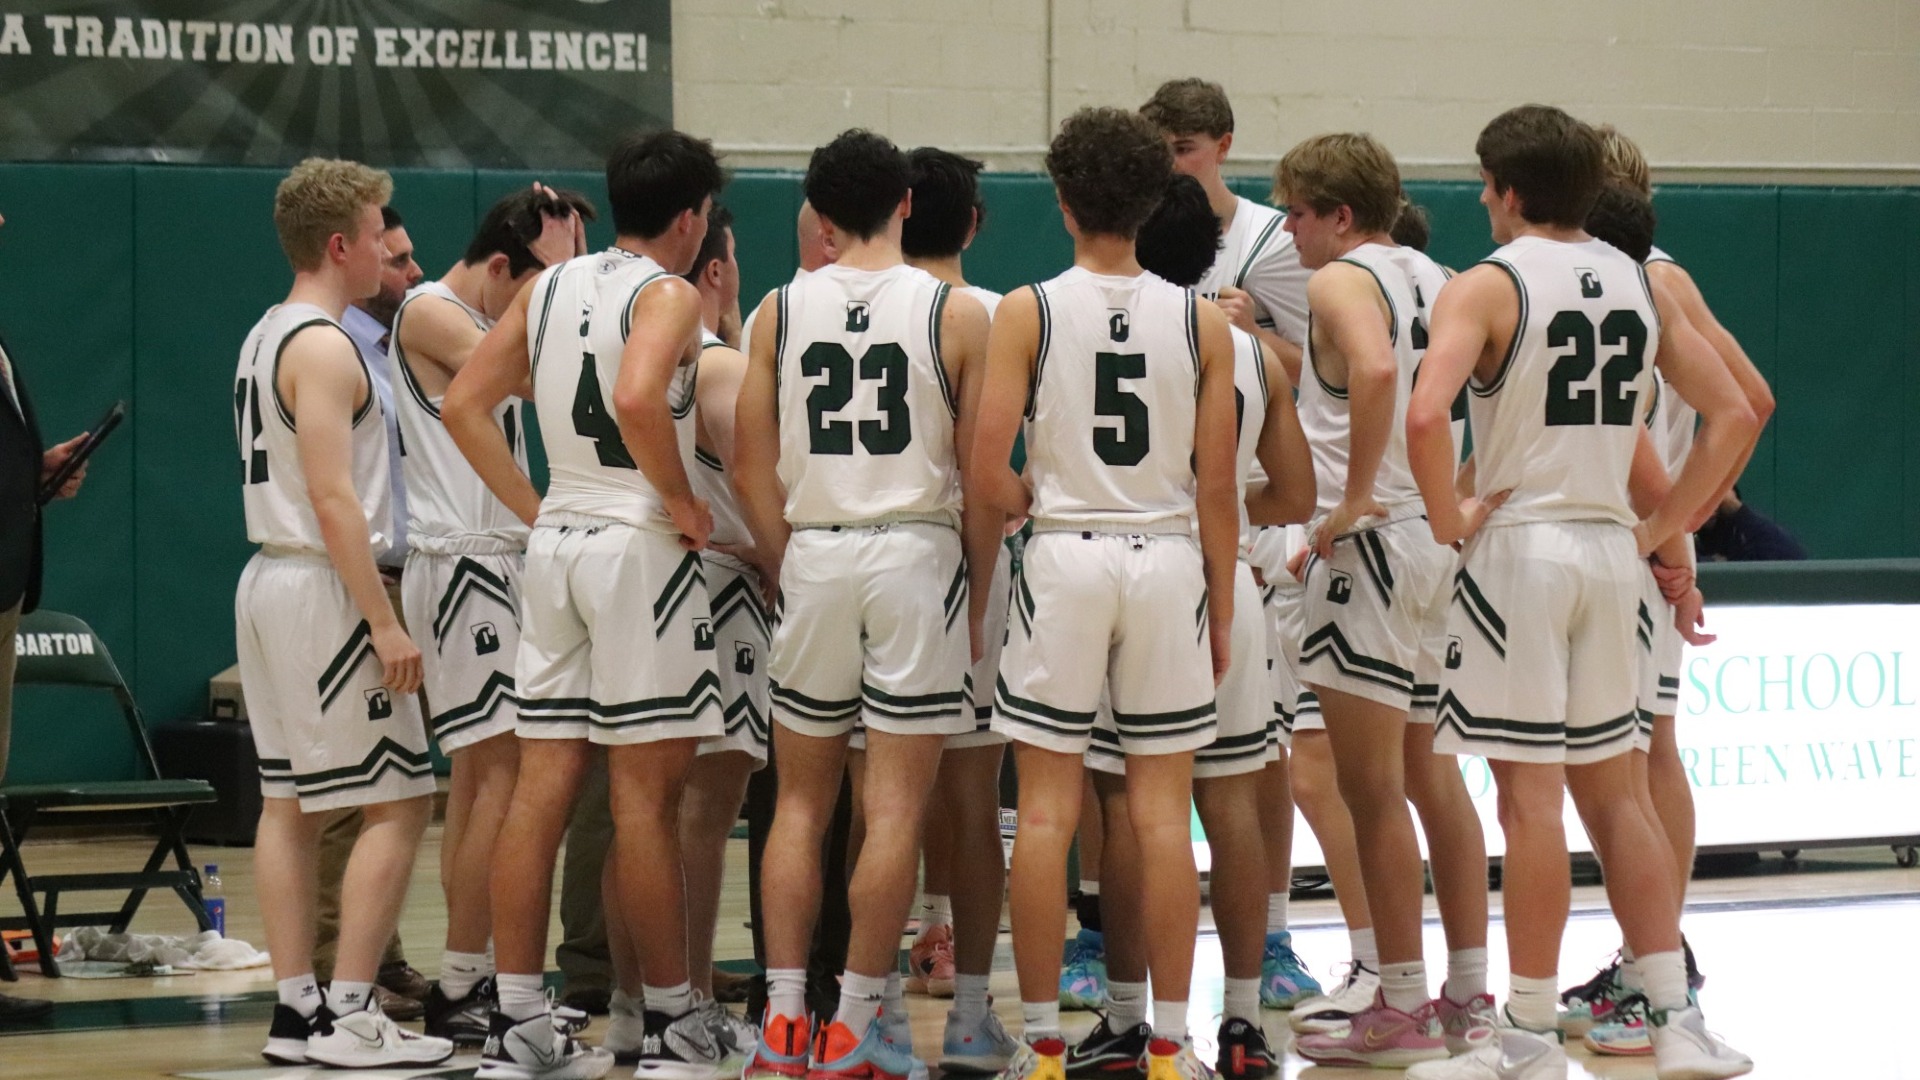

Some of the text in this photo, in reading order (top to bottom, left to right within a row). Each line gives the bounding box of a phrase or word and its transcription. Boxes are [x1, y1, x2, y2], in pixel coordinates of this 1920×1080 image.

[0, 13, 648, 71] A TRADITION OF EXCELLENCE!
[571, 352, 637, 470] 4
[800, 342, 911, 455] 23
[1093, 352, 1149, 466] 5
[1545, 309, 1648, 426] 22
[1686, 651, 1917, 716] SCHOOL
[1680, 738, 1917, 787] REEN WAVE
